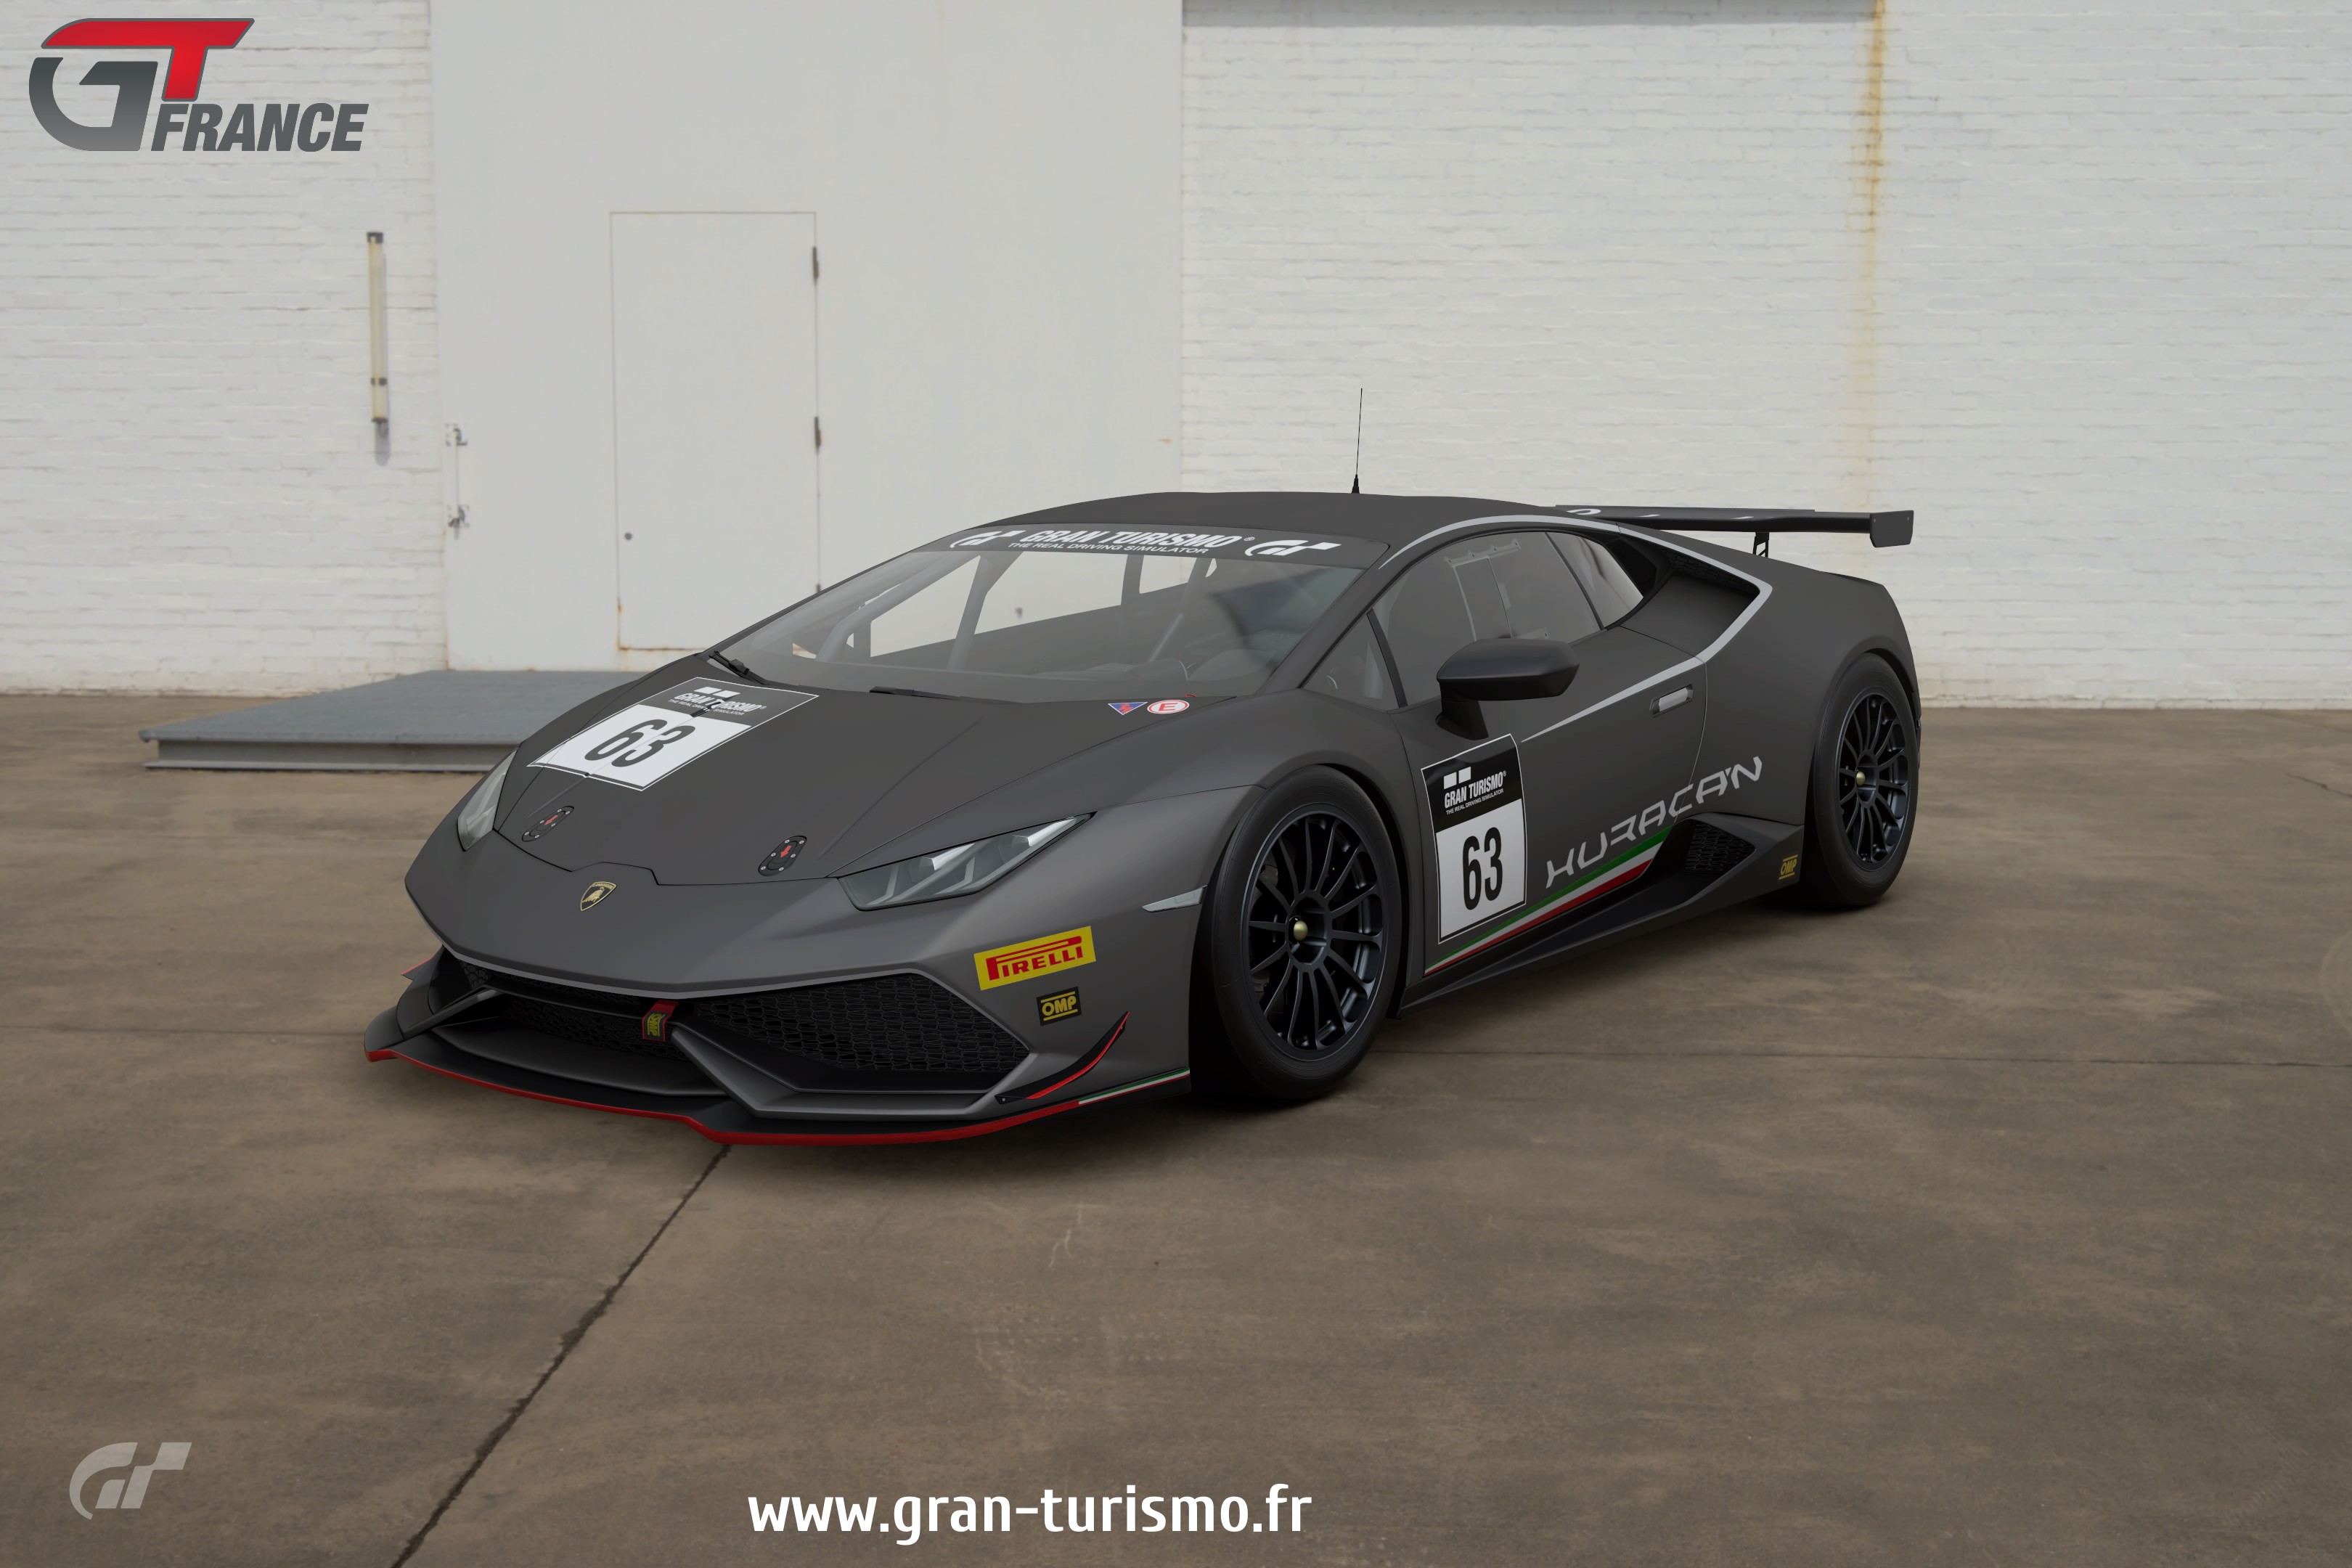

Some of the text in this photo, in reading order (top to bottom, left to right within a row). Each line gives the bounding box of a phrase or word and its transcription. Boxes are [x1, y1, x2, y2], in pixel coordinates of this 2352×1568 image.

[1020, 530, 1111, 543] GRAN
[1123, 545, 1209, 554] SIMULATOR
[674, 693, 714, 705] GRAN
[1159, 702, 1178, 711] E
[584, 719, 696, 768] 63
[1444, 785, 1467, 809] GRAN
[1465, 797, 1482, 808] DRIVING
[1482, 788, 1504, 801] SIMULATOR
[1462, 826, 1503, 911] 63
[1780, 858, 1797, 875] OMP
[985, 935, 1083, 981] PIRELLI
[1042, 995, 1077, 1016] OMP
[649, 1013, 663, 1037] OMP
